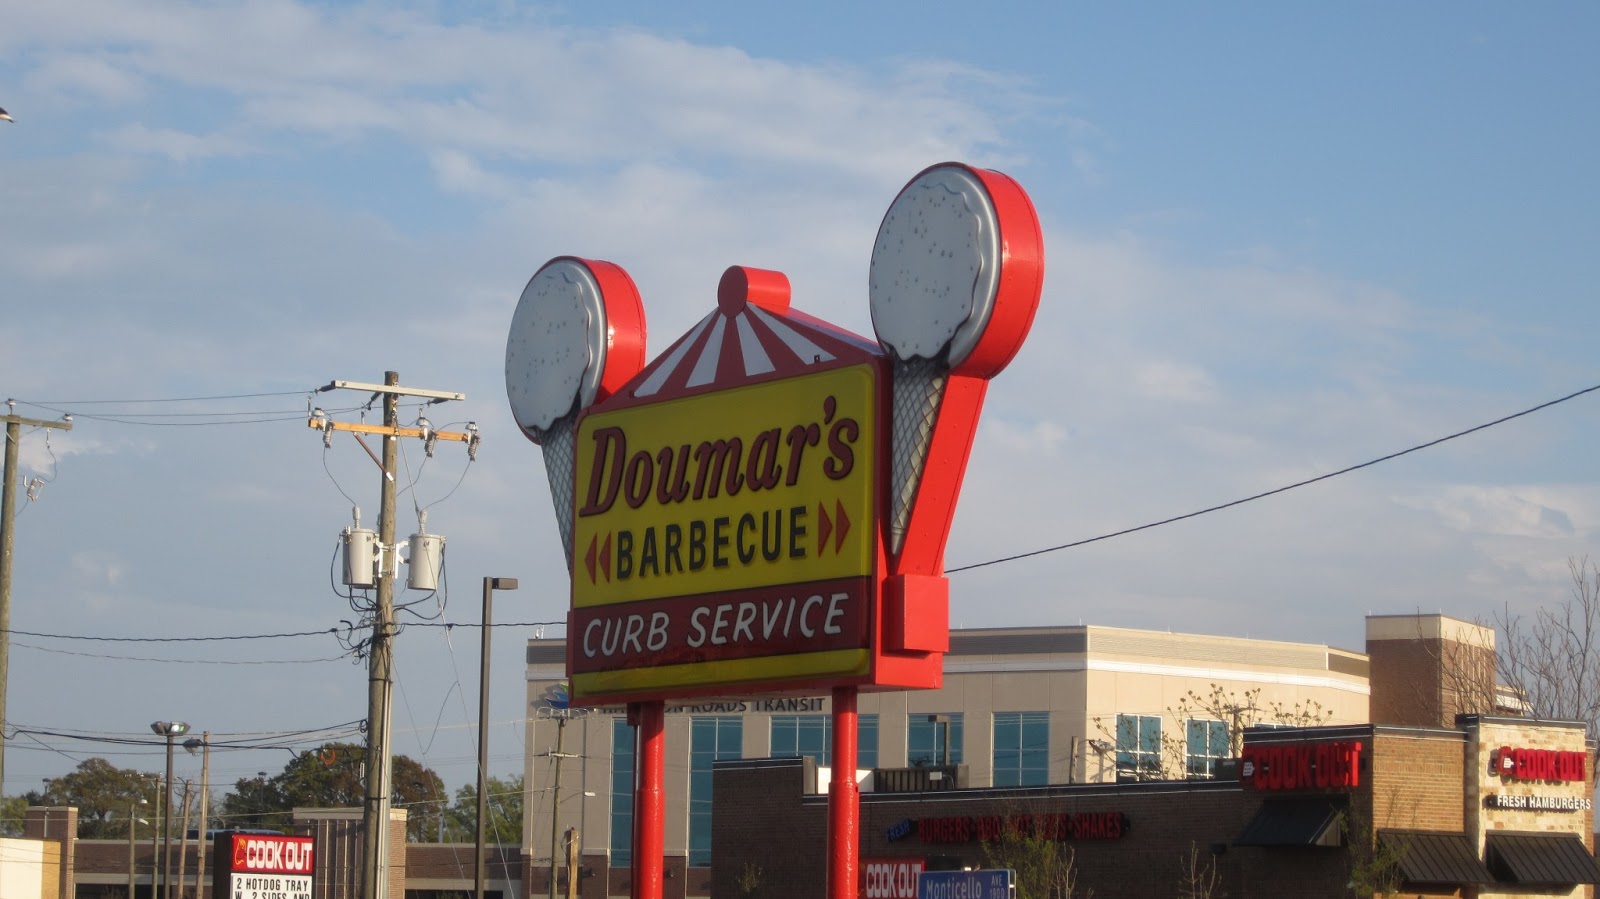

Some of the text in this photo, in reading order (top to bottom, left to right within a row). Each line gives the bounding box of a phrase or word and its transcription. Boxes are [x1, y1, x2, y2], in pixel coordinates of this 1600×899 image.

[578, 396, 859, 518] Doumar's
[616, 506, 808, 579] BARBECUE
[583, 592, 850, 658] CURB SERVICE
[755, 697, 825, 712] TRANSIT
[1254, 745, 1311, 790] COOK
[1516, 748, 1587, 781] COOK OUT
[1497, 795, 1591, 810] FRESH HAMBURGERS
[919, 817, 972, 842] BURGERS
[1074, 812, 1123, 840] SHAKES
[247, 840, 313, 870] COOK OUT
[236, 877, 308, 892] 2 HOTDOG TRAY
[866, 864, 921, 899] COOK OUT
[926, 876, 982, 899] Monticello
[991, 874, 1003, 887] AVE
